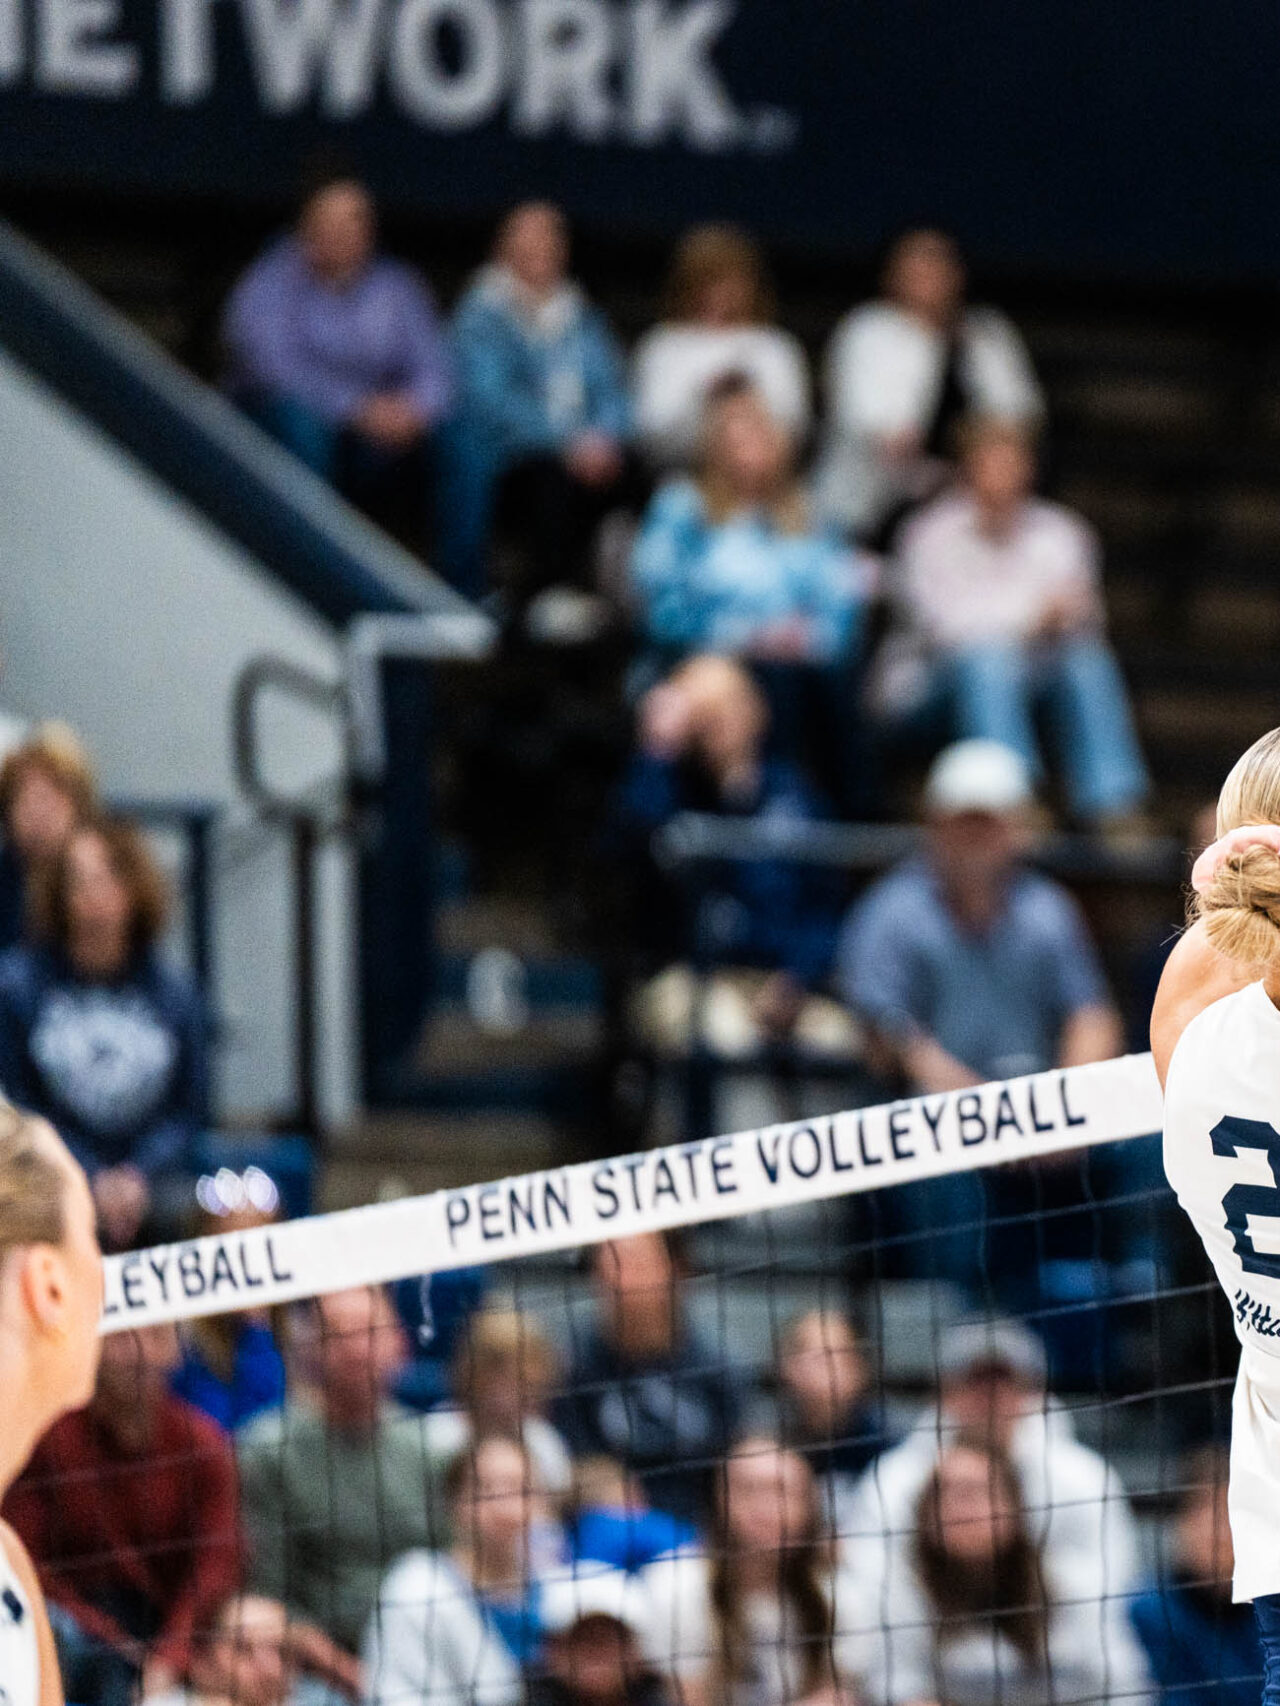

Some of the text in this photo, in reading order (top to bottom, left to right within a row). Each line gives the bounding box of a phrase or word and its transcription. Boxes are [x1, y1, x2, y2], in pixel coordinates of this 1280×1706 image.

[0, 0, 741, 151] ETWORK
[446, 1075, 1088, 1248] PENN STATE VOLLEYBALL
[104, 1236, 293, 1315] EYBALL
